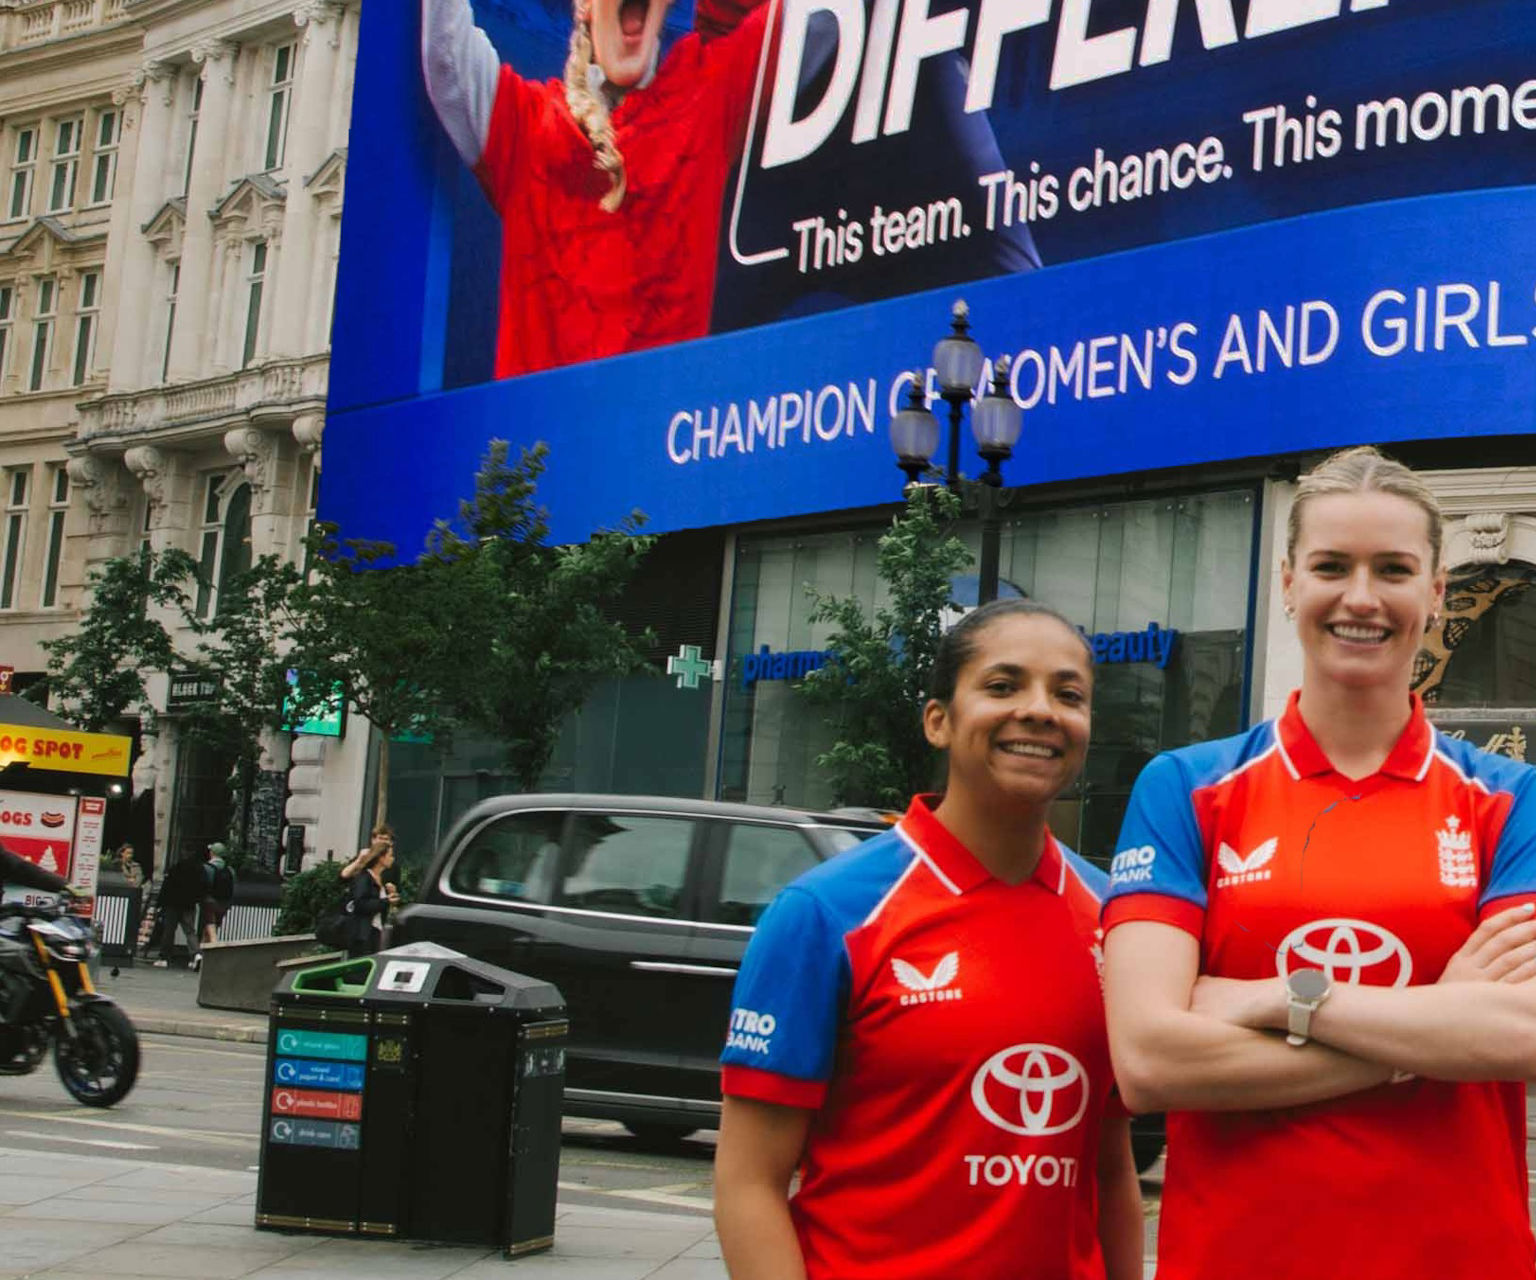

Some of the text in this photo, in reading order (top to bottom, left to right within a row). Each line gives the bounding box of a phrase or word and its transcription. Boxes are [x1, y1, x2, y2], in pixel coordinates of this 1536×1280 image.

[793, 215, 865, 273] This
[870, 195, 971, 257] team.
[979, 164, 1059, 232] This
[1066, 137, 1233, 212] chance.
[1242, 96, 1342, 172] This
[666, 375, 878, 467] CHAMPION
[1212, 300, 1342, 379] AND
[1077, 621, 1179, 670] eauty
[743, 644, 846, 689] pharm
[32, 738, 85, 761] SPOT
[0, 810, 33, 826] OGS
[1216, 869, 1272, 889] CASTORE
[900, 988, 963, 1007] CASTORE
[964, 1153, 1078, 1188] TOYOT
